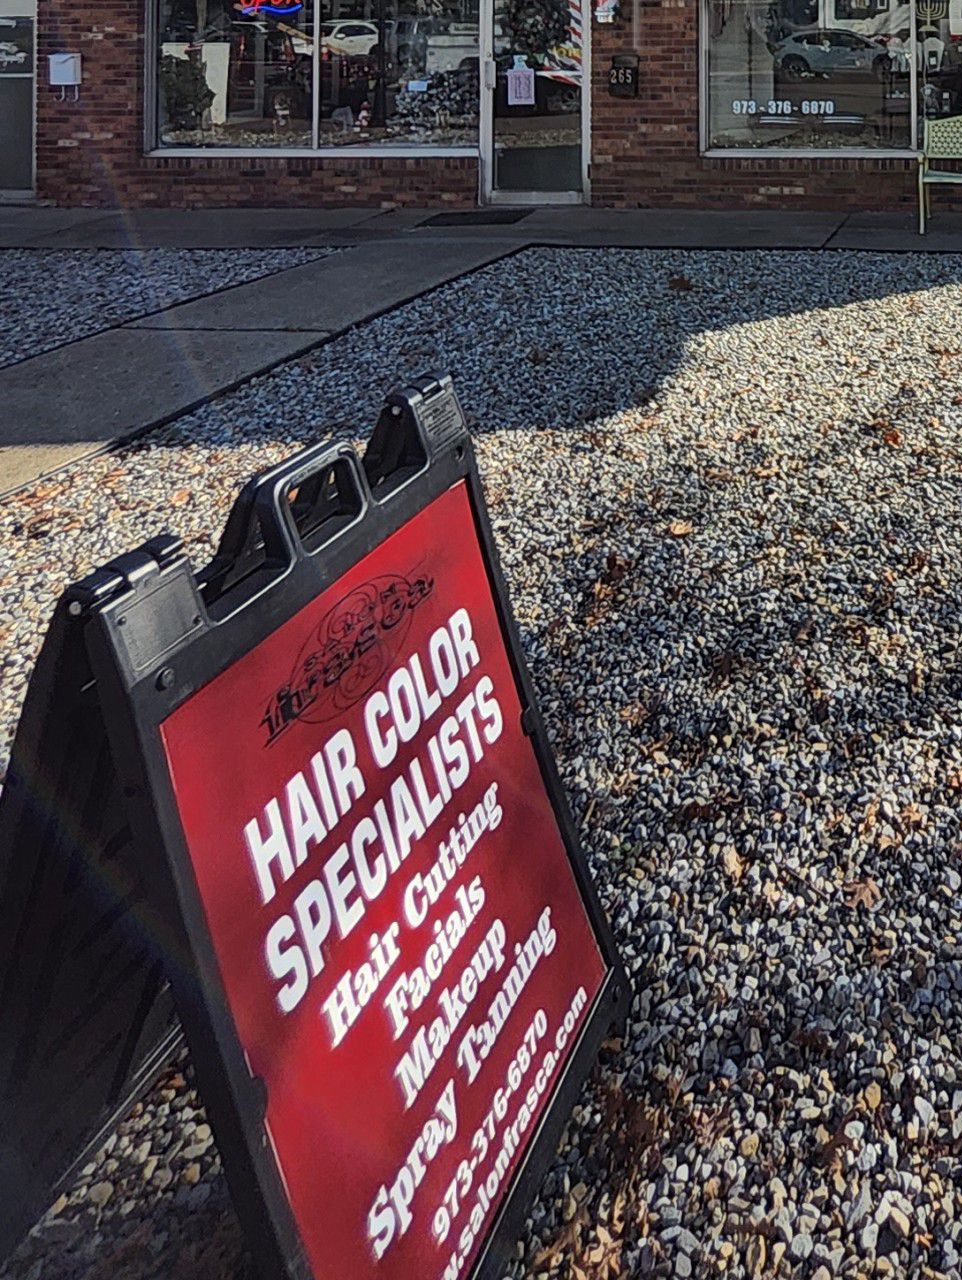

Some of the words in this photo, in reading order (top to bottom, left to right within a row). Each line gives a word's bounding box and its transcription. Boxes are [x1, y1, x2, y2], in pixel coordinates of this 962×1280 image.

[610, 69, 632, 84] 265
[244, 728, 367, 905] HAIR
[364, 607, 481, 769] COLOR
[265, 675, 504, 1014] SPECIALISTS
[320, 921, 401, 1050] Hair
[403, 781, 503, 930] Cutting
[383, 875, 486, 1041] Facials
[395, 918, 506, 1110] Makeup
[367, 1077, 457, 1261] Spray
[456, 906, 556, 1085] Tanning
[432, 1008, 548, 1246] 973-376-6870
